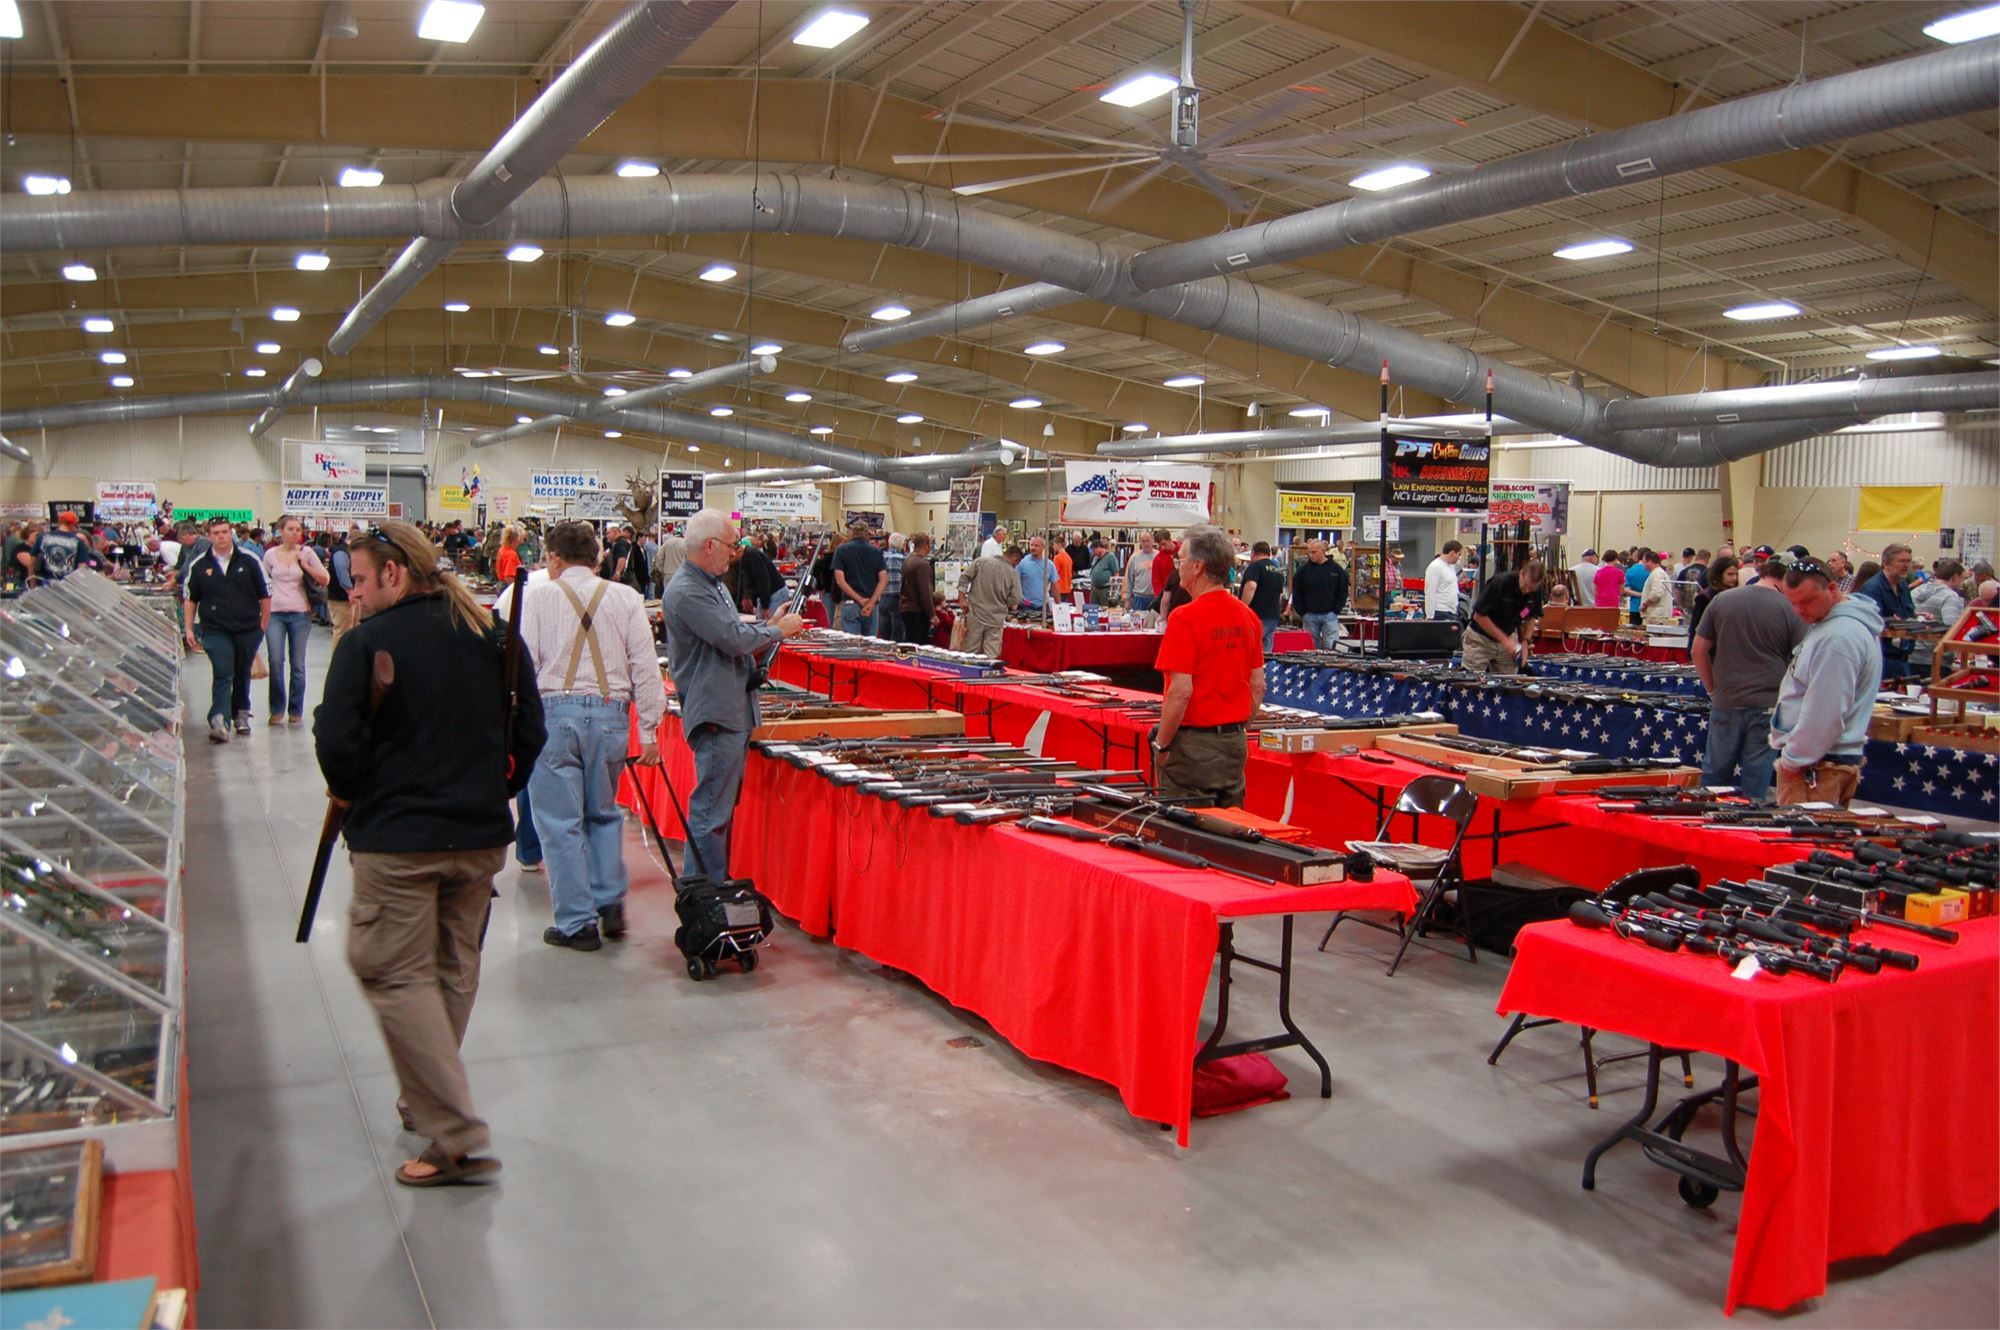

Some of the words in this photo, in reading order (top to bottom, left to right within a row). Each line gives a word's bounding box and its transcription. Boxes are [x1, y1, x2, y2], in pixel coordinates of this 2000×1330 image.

[1394, 440, 1433, 458] PF
[1433, 442, 1459, 459] Custom
[1392, 462, 1411, 478] HK
[1420, 465, 1489, 481] BUSHMASTER
[534, 475, 584, 486] HOLSTERS
[589, 477, 596, 486] &
[671, 480, 687, 488] CLASS
[1148, 480, 1169, 488] NORTH
[1170, 481, 1200, 490] CAROLINA
[343, 491, 384, 501] SUPPLY
[534, 488, 576, 497] ACCESSO
[674, 490, 690, 499] SOUND
[1150, 490, 1175, 498] CITIZEN
[1176, 491, 1197, 499] MILITIA
[1393, 492, 1410, 500] NC's
[1412, 492, 1437, 503] Largest
[1439, 493, 1456, 502] Class
[1464, 494, 1487, 503] Dealer
[664, 500, 699, 510] SUPPRESSORS
[1488, 499, 1550, 514] EORGIA
